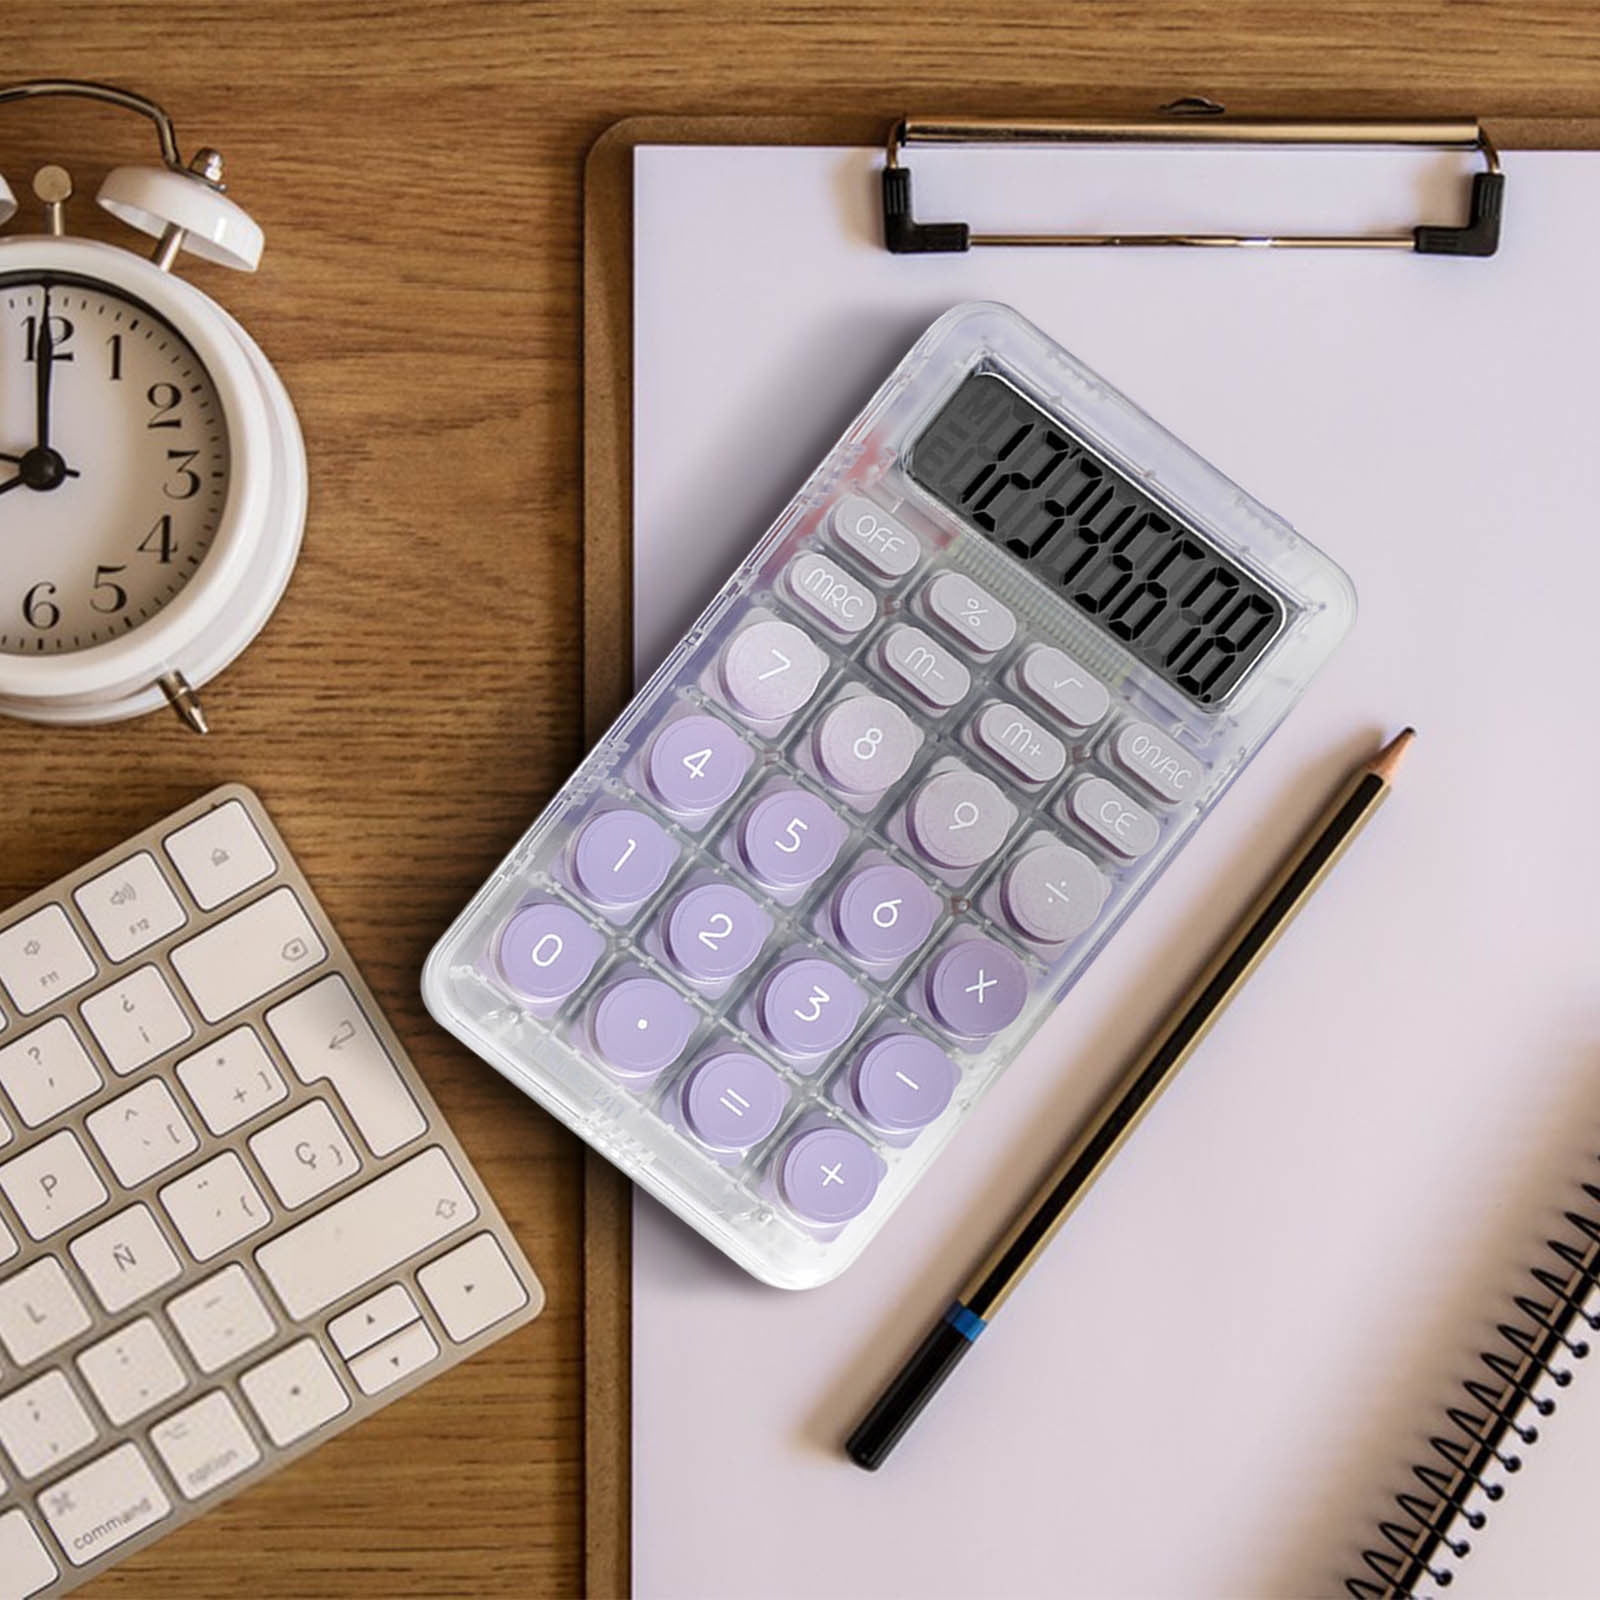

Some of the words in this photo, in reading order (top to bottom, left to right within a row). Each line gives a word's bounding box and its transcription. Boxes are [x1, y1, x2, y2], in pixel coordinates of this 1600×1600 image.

[20, 316, 74, 361] 12
[106, 334, 122, 380] 1
[147, 382, 182, 429] 2
[162, 450, 200, 499] 3
[138, 515, 178, 564] 4
[856, 515, 905, 556] OFF
[90, 565, 127, 613] 5
[804, 567, 863, 618] MRC
[22, 582, 60, 630] 6
[961, 599, 988, 626] %
[758, 650, 790, 680] 7
[854, 728, 882, 759] 8
[1000, 722, 1043, 757] M+
[683, 749, 712, 778] 4
[949, 802, 978, 829] 9
[1099, 799, 1138, 836] CE
[775, 818, 807, 852] 5
[614, 839, 635, 871] 1
[1046, 882, 1069, 903] ÷
[129, 918, 149, 934] F12
[873, 900, 901, 927] 6
[699, 914, 732, 950] 2
[532, 934, 562, 966] 0
[795, 986, 829, 1021] 3
[234, 1090, 246, 1102] +
[720, 1089, 749, 1116] =
[295, 1142, 316, 1169] Ç
[40, 1175, 57, 1198] P
[821, 1163, 843, 1185] +
[113, 1244, 136, 1270] Ñ
[26, 1304, 46, 1324] L
[73, 1497, 153, 1551] command
